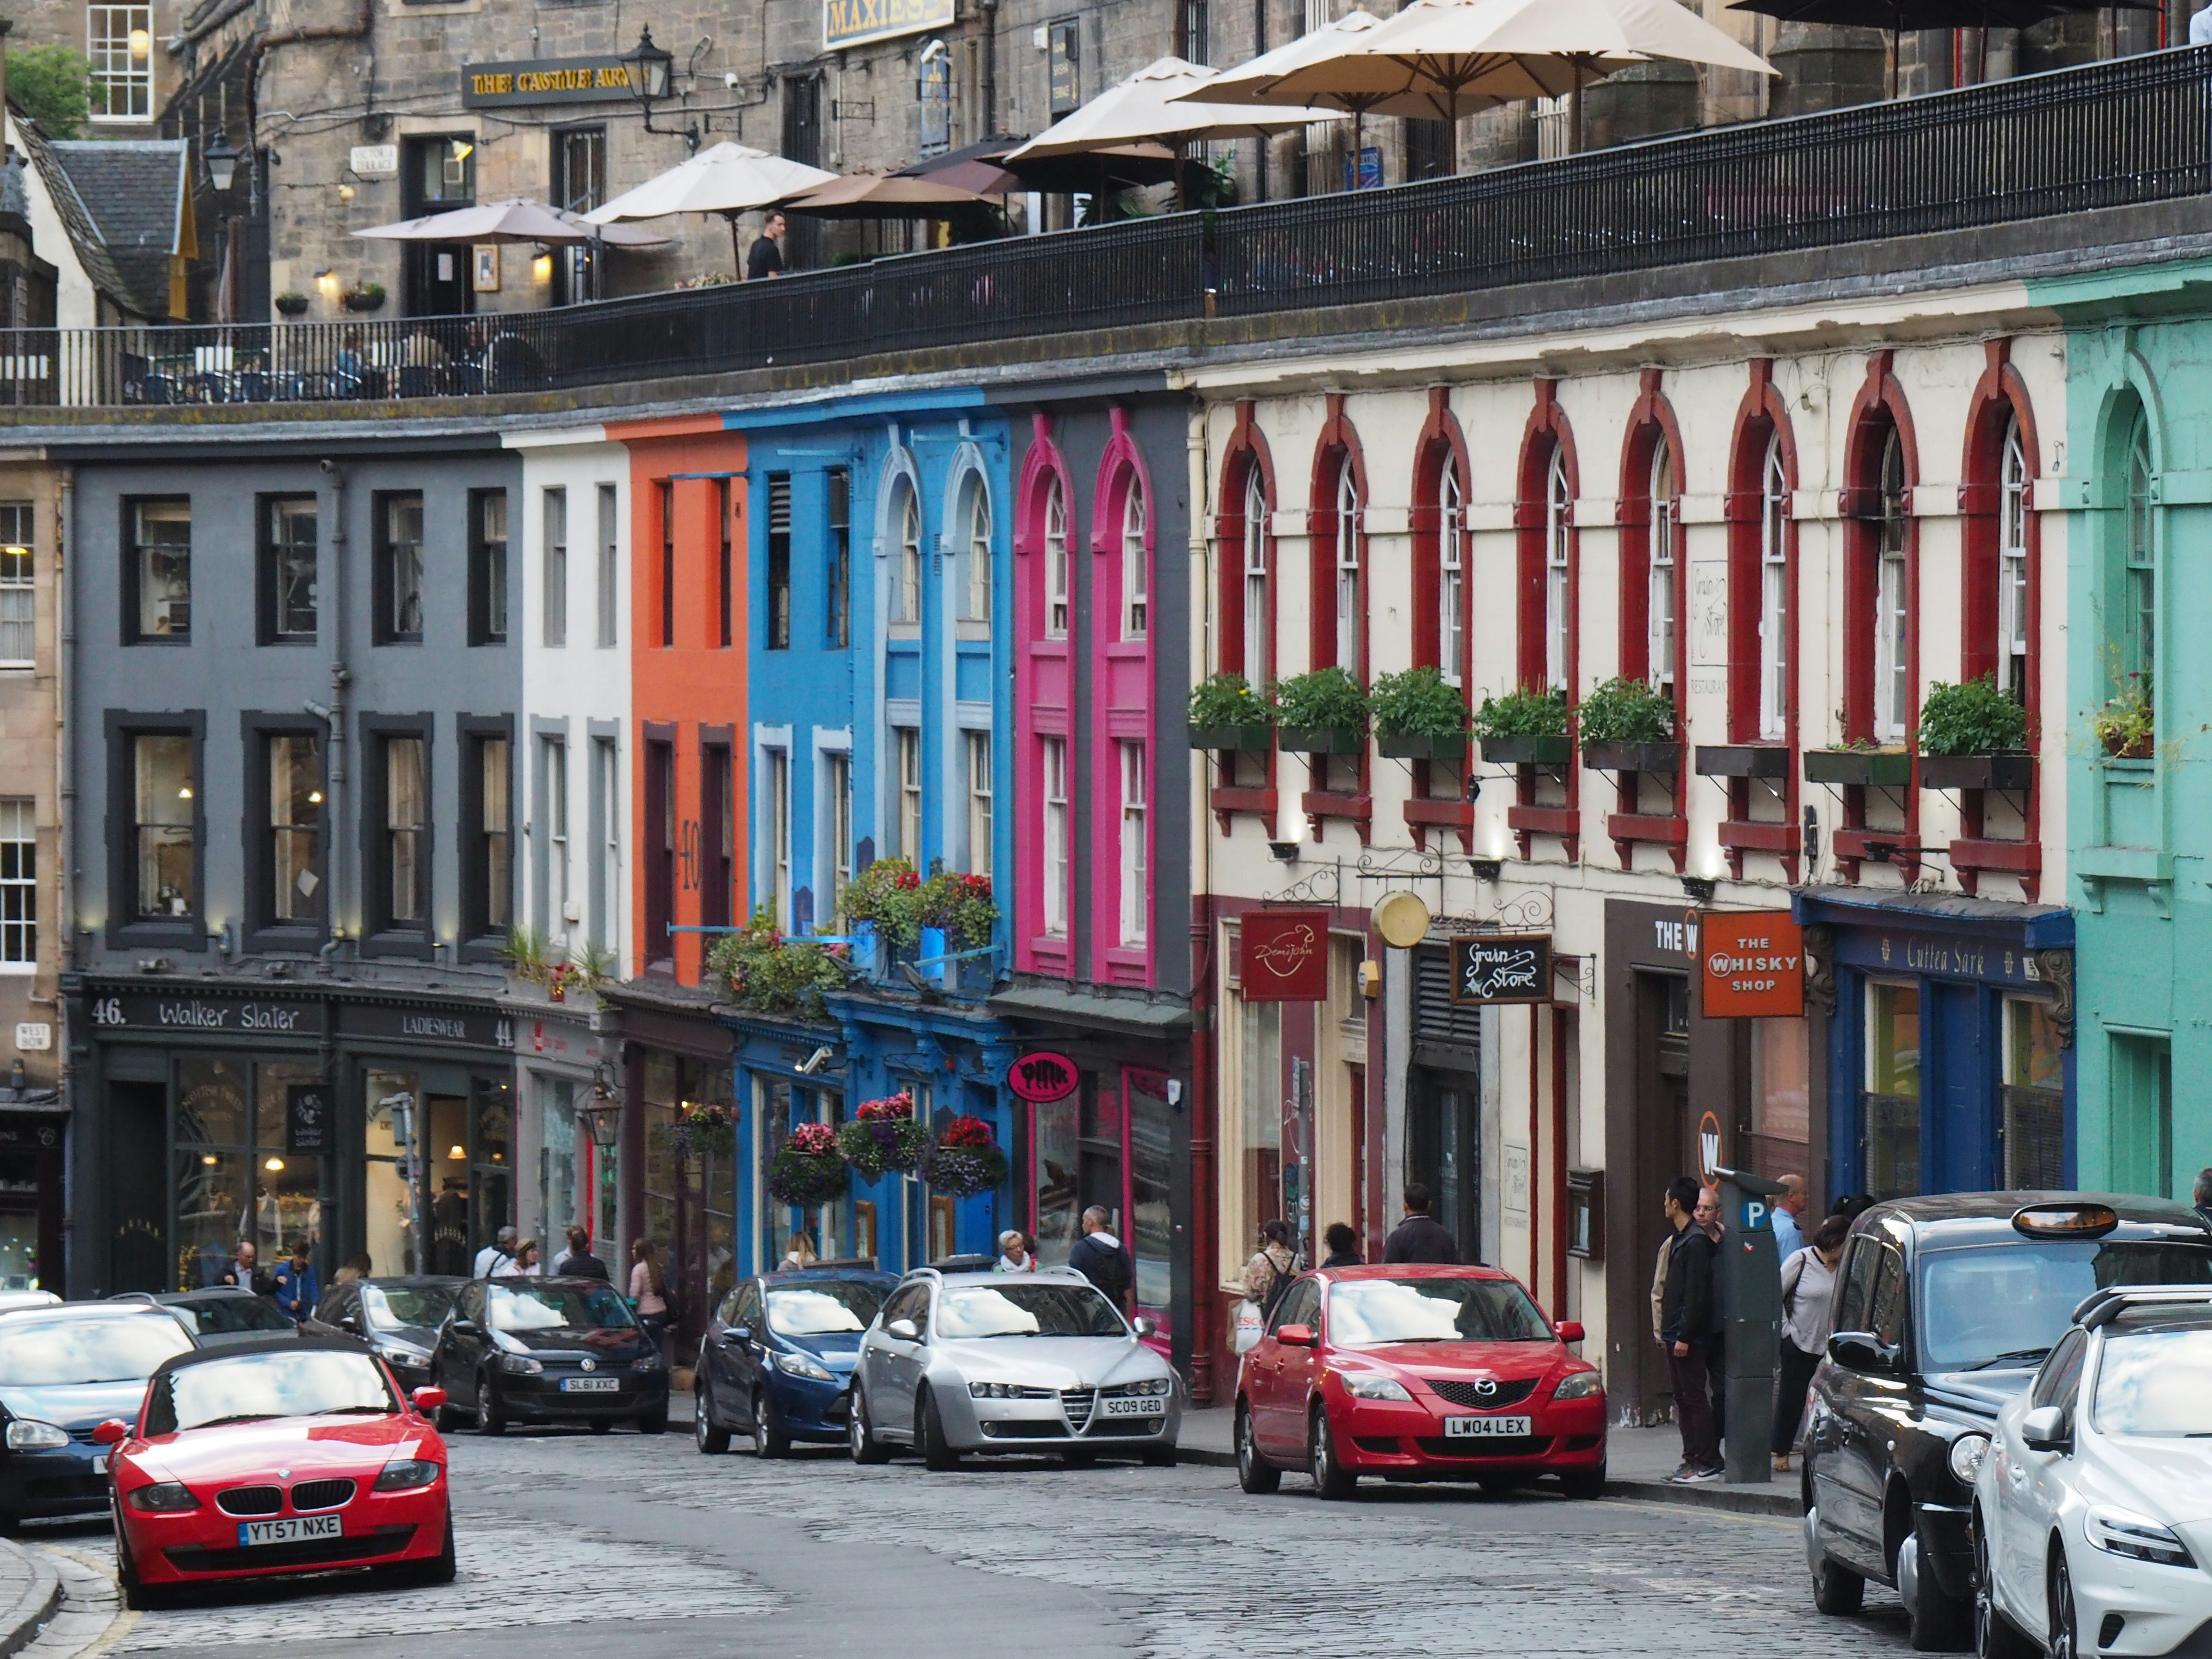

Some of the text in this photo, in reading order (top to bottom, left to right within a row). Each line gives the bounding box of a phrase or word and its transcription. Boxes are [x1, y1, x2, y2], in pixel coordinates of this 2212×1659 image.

[471, 73, 513, 95] THE
[517, 68, 593, 92] CASTLE
[1655, 921, 1682, 950] THE
[1737, 938, 1769, 949] THE
[1466, 943, 1510, 977] Grain
[1711, 957, 1797, 972] WHISKY
[1954, 941, 1984, 975] Sark
[1731, 980, 1775, 991] SHOP
[159, 1000, 229, 1026] Walker
[241, 1002, 300, 1029] Slater
[21, 1025, 47, 1036] WEST
[403, 1016, 465, 1038] LADIESWEAR
[22, 1036, 44, 1047] BOW
[1748, 1202, 1765, 1228] P
[569, 1380, 593, 1390] SL61
[1108, 1400, 1161, 1413] SC09 GED
[1452, 1419, 1525, 1434] LW04 LEX
[250, 1516, 338, 1540] YT57 NXE
